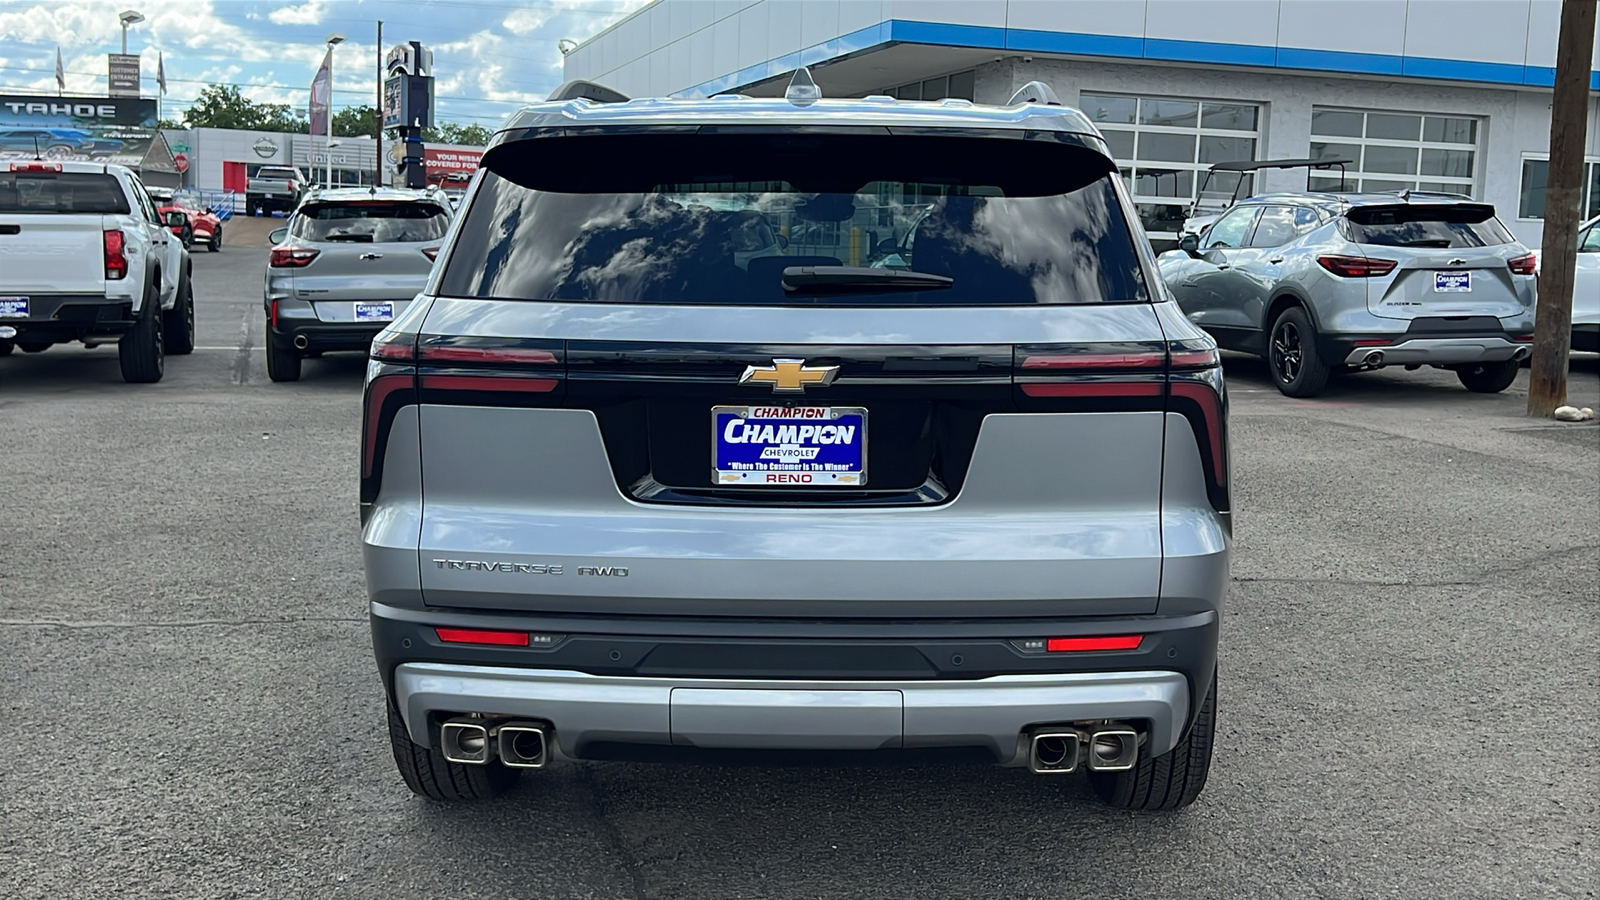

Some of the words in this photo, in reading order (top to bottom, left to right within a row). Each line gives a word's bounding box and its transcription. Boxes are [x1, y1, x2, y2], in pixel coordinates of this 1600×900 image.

[5, 102, 116, 118] TAHOE
[437, 153, 457, 161] YOUR
[458, 155, 481, 163] NISSA
[426, 160, 461, 168] COVERED
[753, 407, 826, 419] CHAMPION
[723, 418, 856, 445] CHAMPION
[764, 448, 815, 457] CHEVROLET
[755, 462, 768, 471] The
[769, 462, 802, 471] Customer
[802, 463, 810, 471] Is
[811, 463, 824, 471] The
[766, 474, 813, 483] RENO
[432, 558, 564, 575] TRAVERSE
[577, 565, 630, 577] AWD
